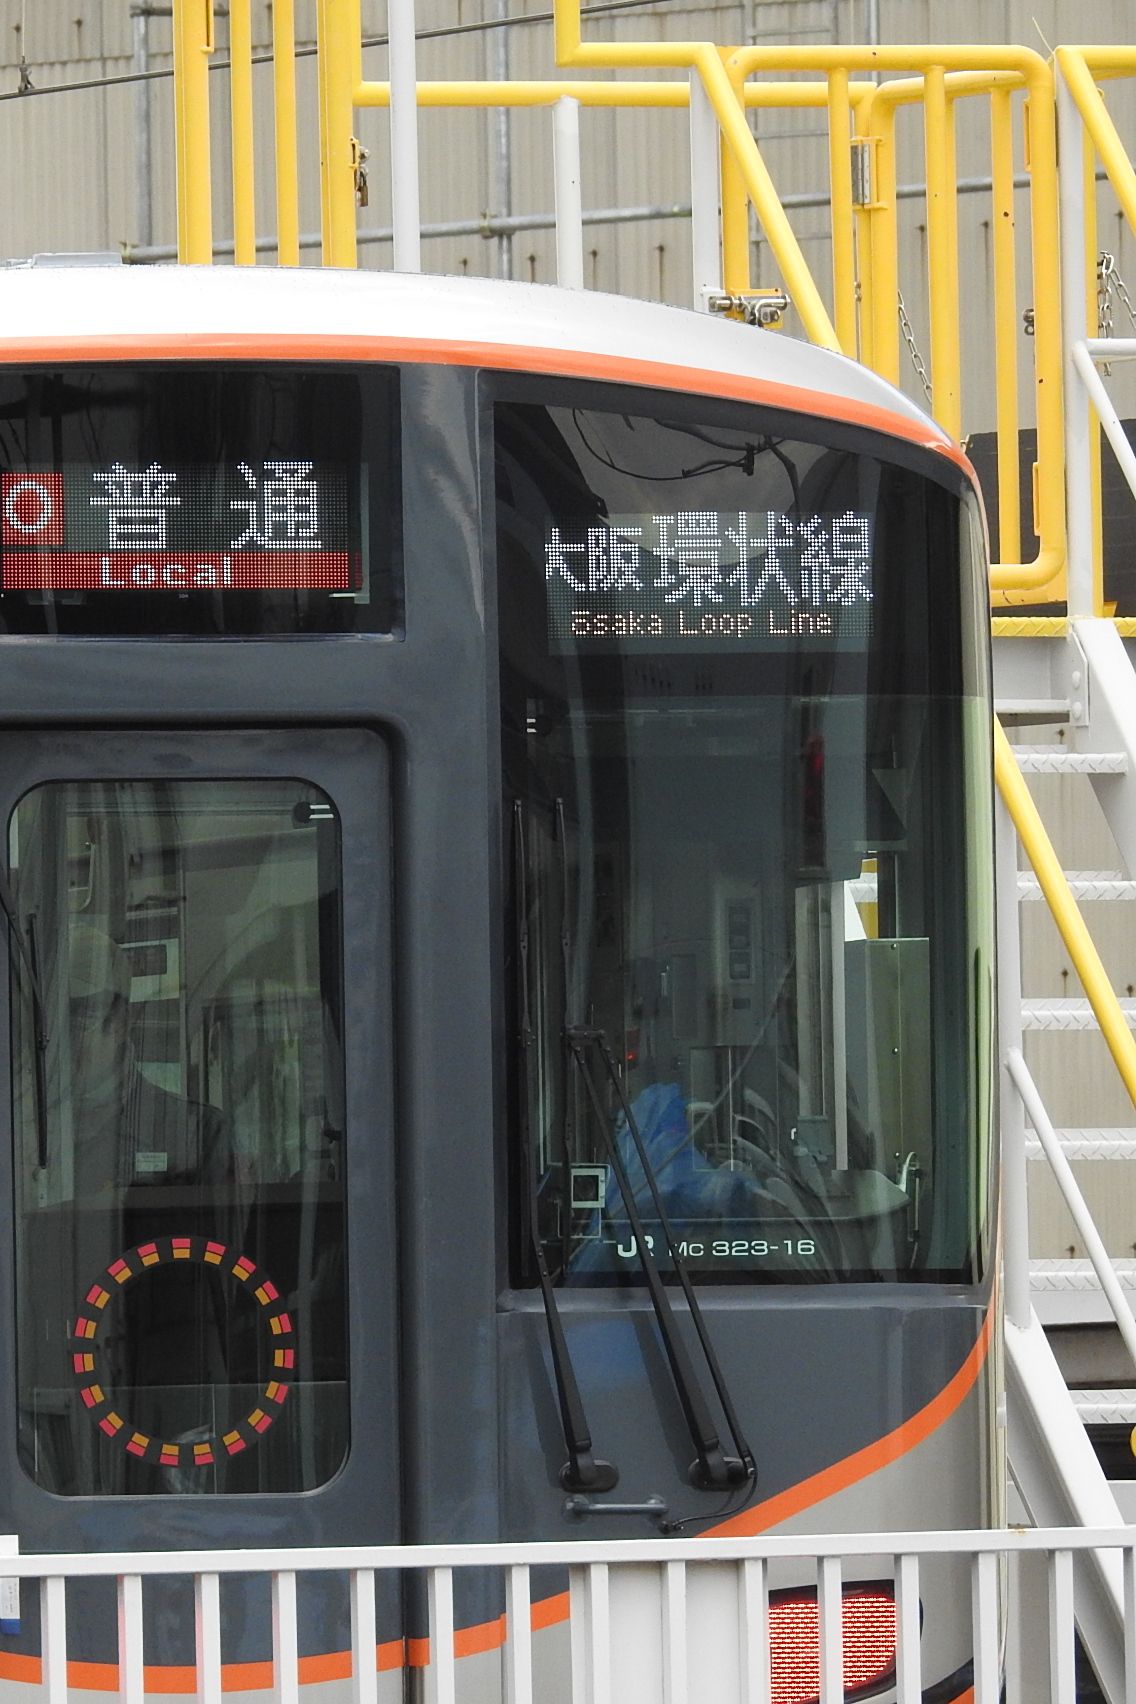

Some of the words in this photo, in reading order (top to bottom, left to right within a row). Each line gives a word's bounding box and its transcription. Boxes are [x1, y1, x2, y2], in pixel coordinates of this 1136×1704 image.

[89, 461, 323, 549] 普通
[101, 556, 232, 586] Local
[544, 510, 874, 607] 大阪環状線
[679, 610, 752, 637] Loop
[769, 610, 832, 634] Line
[712, 1239, 815, 1256] 323-16
